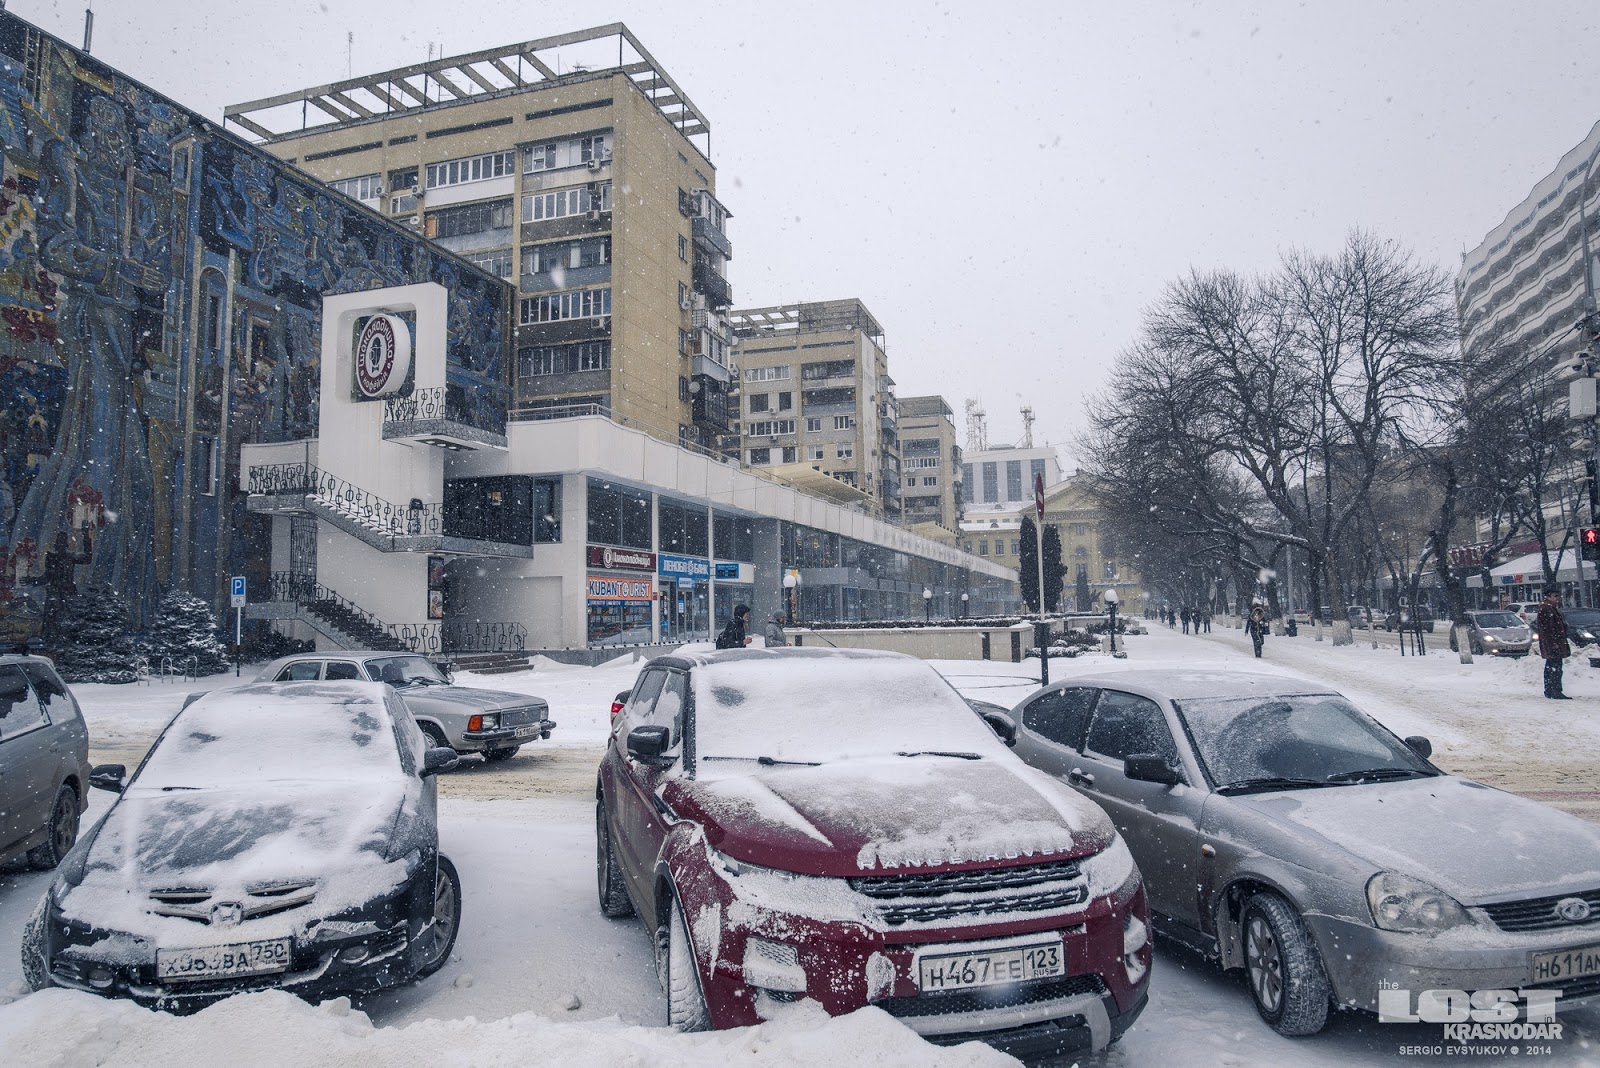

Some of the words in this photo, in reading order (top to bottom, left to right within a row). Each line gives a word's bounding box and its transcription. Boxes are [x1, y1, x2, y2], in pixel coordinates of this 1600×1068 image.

[234, 580, 242, 595] P
[252, 943, 284, 961] 750
[1026, 947, 1058, 970] 123
